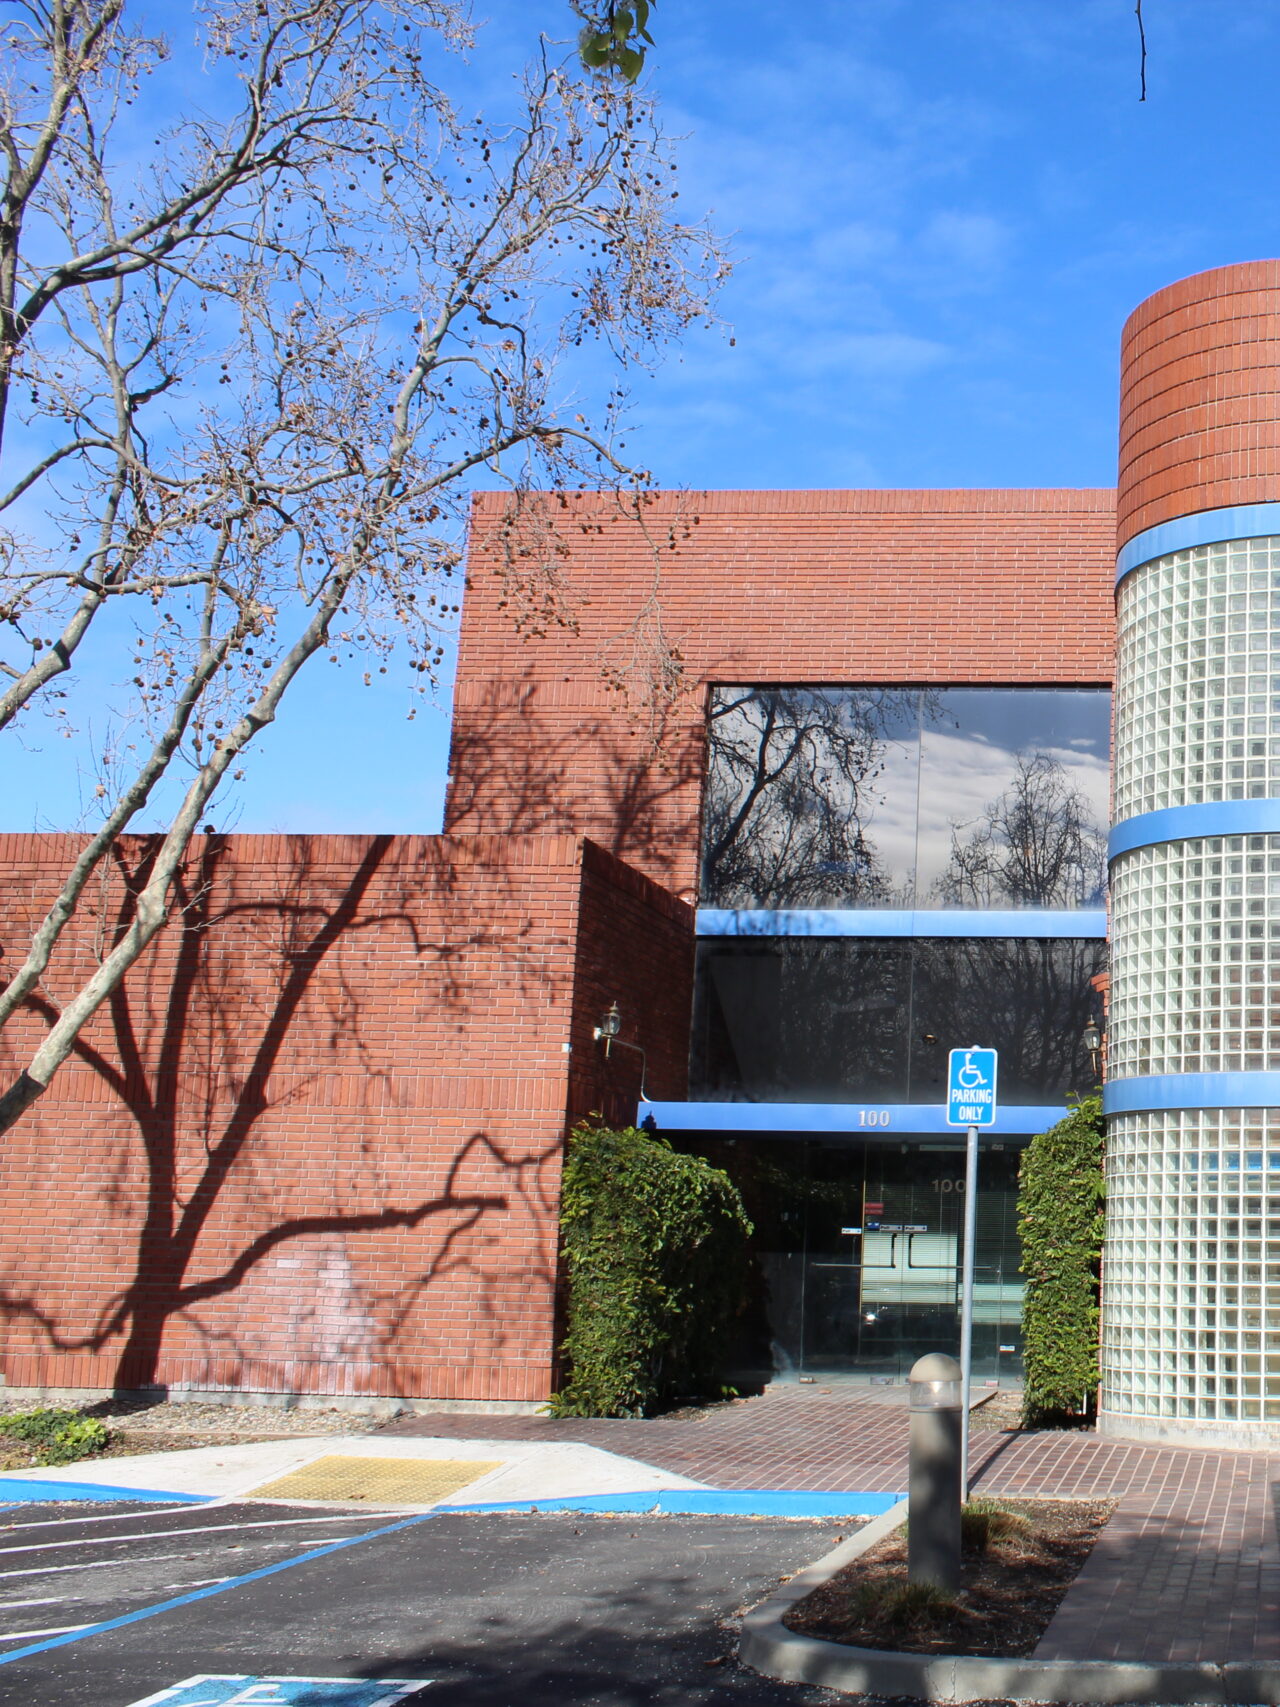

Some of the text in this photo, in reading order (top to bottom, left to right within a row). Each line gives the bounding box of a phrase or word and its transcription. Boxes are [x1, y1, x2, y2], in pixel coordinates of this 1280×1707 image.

[951, 1088, 992, 1104] PARKING
[858, 1110, 891, 1127] 100
[958, 1106, 984, 1121] ONLY
[931, 1178, 967, 1193] 100
